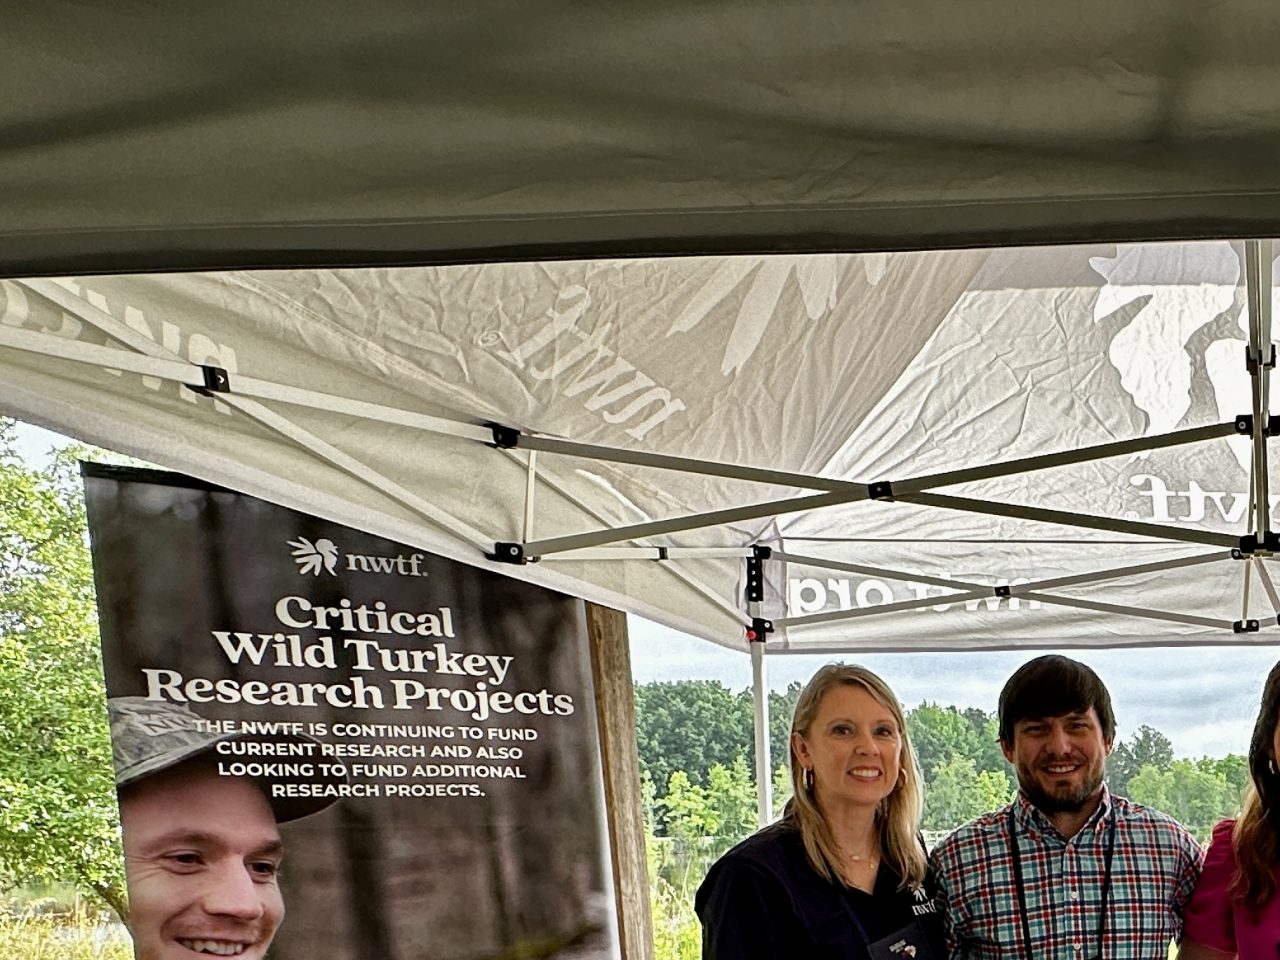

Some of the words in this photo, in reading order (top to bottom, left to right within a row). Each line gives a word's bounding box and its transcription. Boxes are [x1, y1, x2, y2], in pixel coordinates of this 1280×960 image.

[275, 596, 455, 638] Critical
[211, 631, 337, 669] Wild
[344, 639, 514, 686] Turkey
[142, 668, 384, 709] Research
[390, 679, 575, 721] Projects
[192, 719, 235, 733] THE
[241, 721, 303, 736] NWTF
[309, 723, 328, 736] IS
[332, 723, 455, 738] CONTINUING
[458, 726, 483, 739] TO
[488, 728, 537, 741] FUND
[216, 741, 316, 756] CURRENT
[321, 743, 425, 757] RESEARCH
[431, 745, 472, 758] AND
[476, 746, 523, 760] ALSO
[218, 762, 314, 777] LOOKING
[318, 764, 347, 776] TO
[352, 764, 407, 777] FUND
[412, 764, 526, 778] ADDITIONAL
[271, 784, 380, 797] RESEARCH
[385, 784, 486, 797] PROJECTS.
